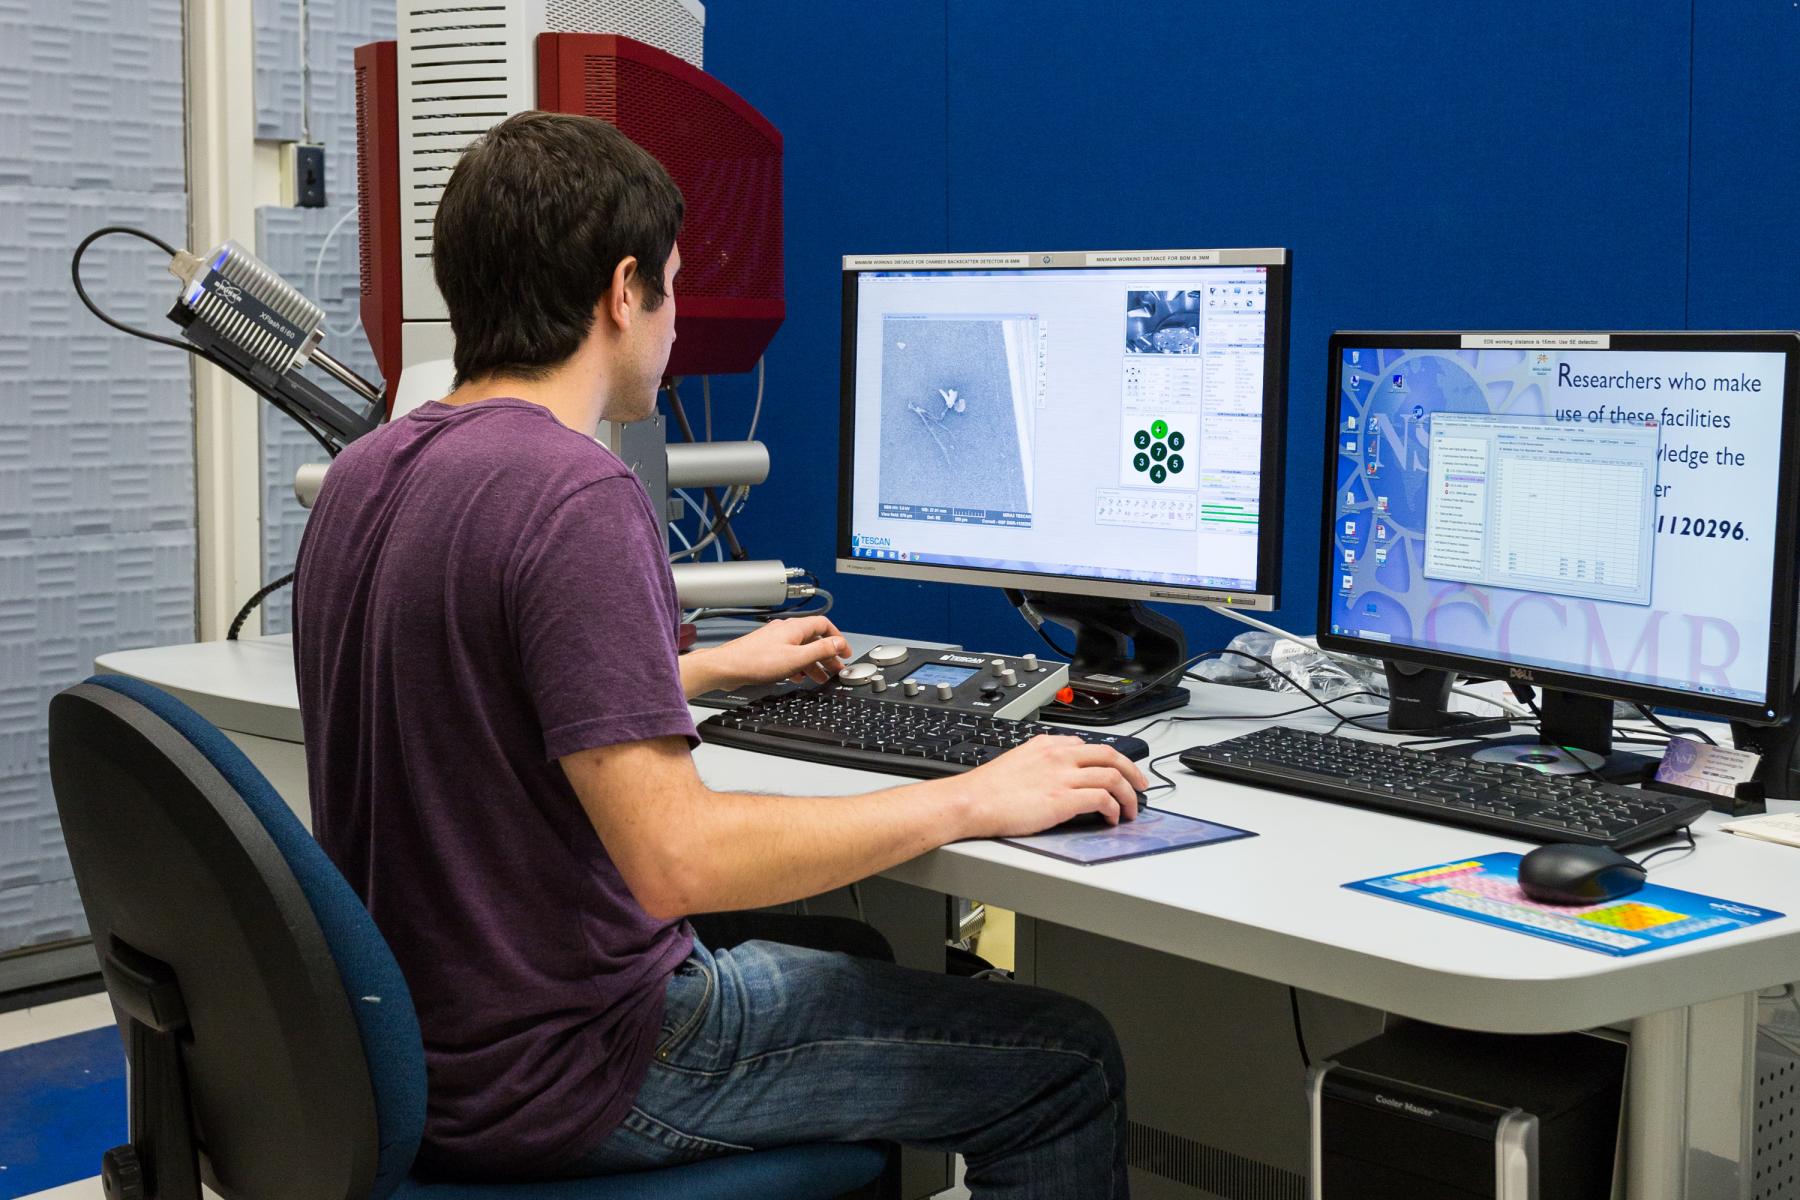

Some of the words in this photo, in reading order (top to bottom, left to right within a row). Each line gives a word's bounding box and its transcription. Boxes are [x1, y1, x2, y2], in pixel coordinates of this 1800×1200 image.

[259, 311, 280, 330] XFlash
[1558, 363, 1661, 390] Researchers
[1668, 372, 1707, 391] who
[1713, 373, 1762, 392] make
[1555, 408, 1582, 422] use
[1588, 405, 1606, 423] of
[1610, 406, 1655, 425] these
[1661, 407, 1731, 428] facilities
[1716, 446, 1745, 466] the
[1657, 515, 1750, 541] 1120296.
[861, 536, 891, 547] TESCAN
[1425, 584, 1741, 687] CCMR
[1509, 667, 1534, 681] DELL
[1375, 1094, 1404, 1108] Cooler
